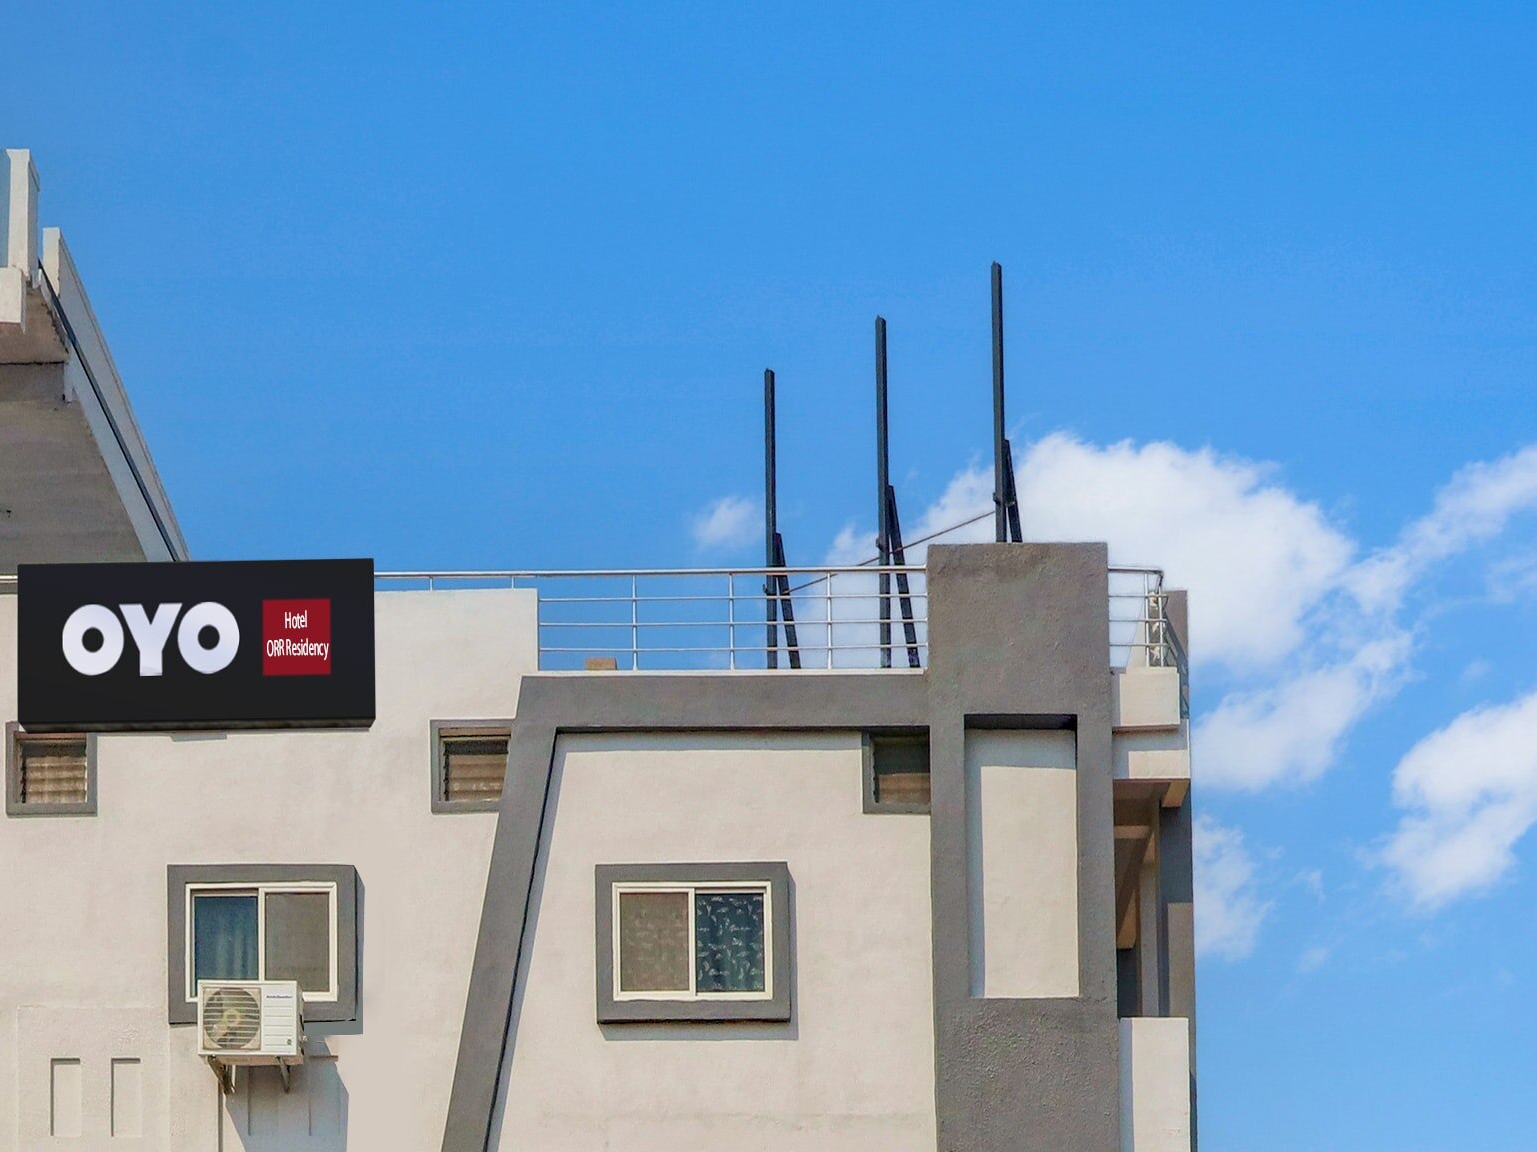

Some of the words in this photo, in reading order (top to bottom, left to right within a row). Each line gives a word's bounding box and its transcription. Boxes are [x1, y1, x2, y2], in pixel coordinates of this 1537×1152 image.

[284, 610, 308, 630] Hotel
[62, 601, 240, 676] OYO
[266, 639, 285, 657] ORR
[286, 637, 330, 660] Residency
